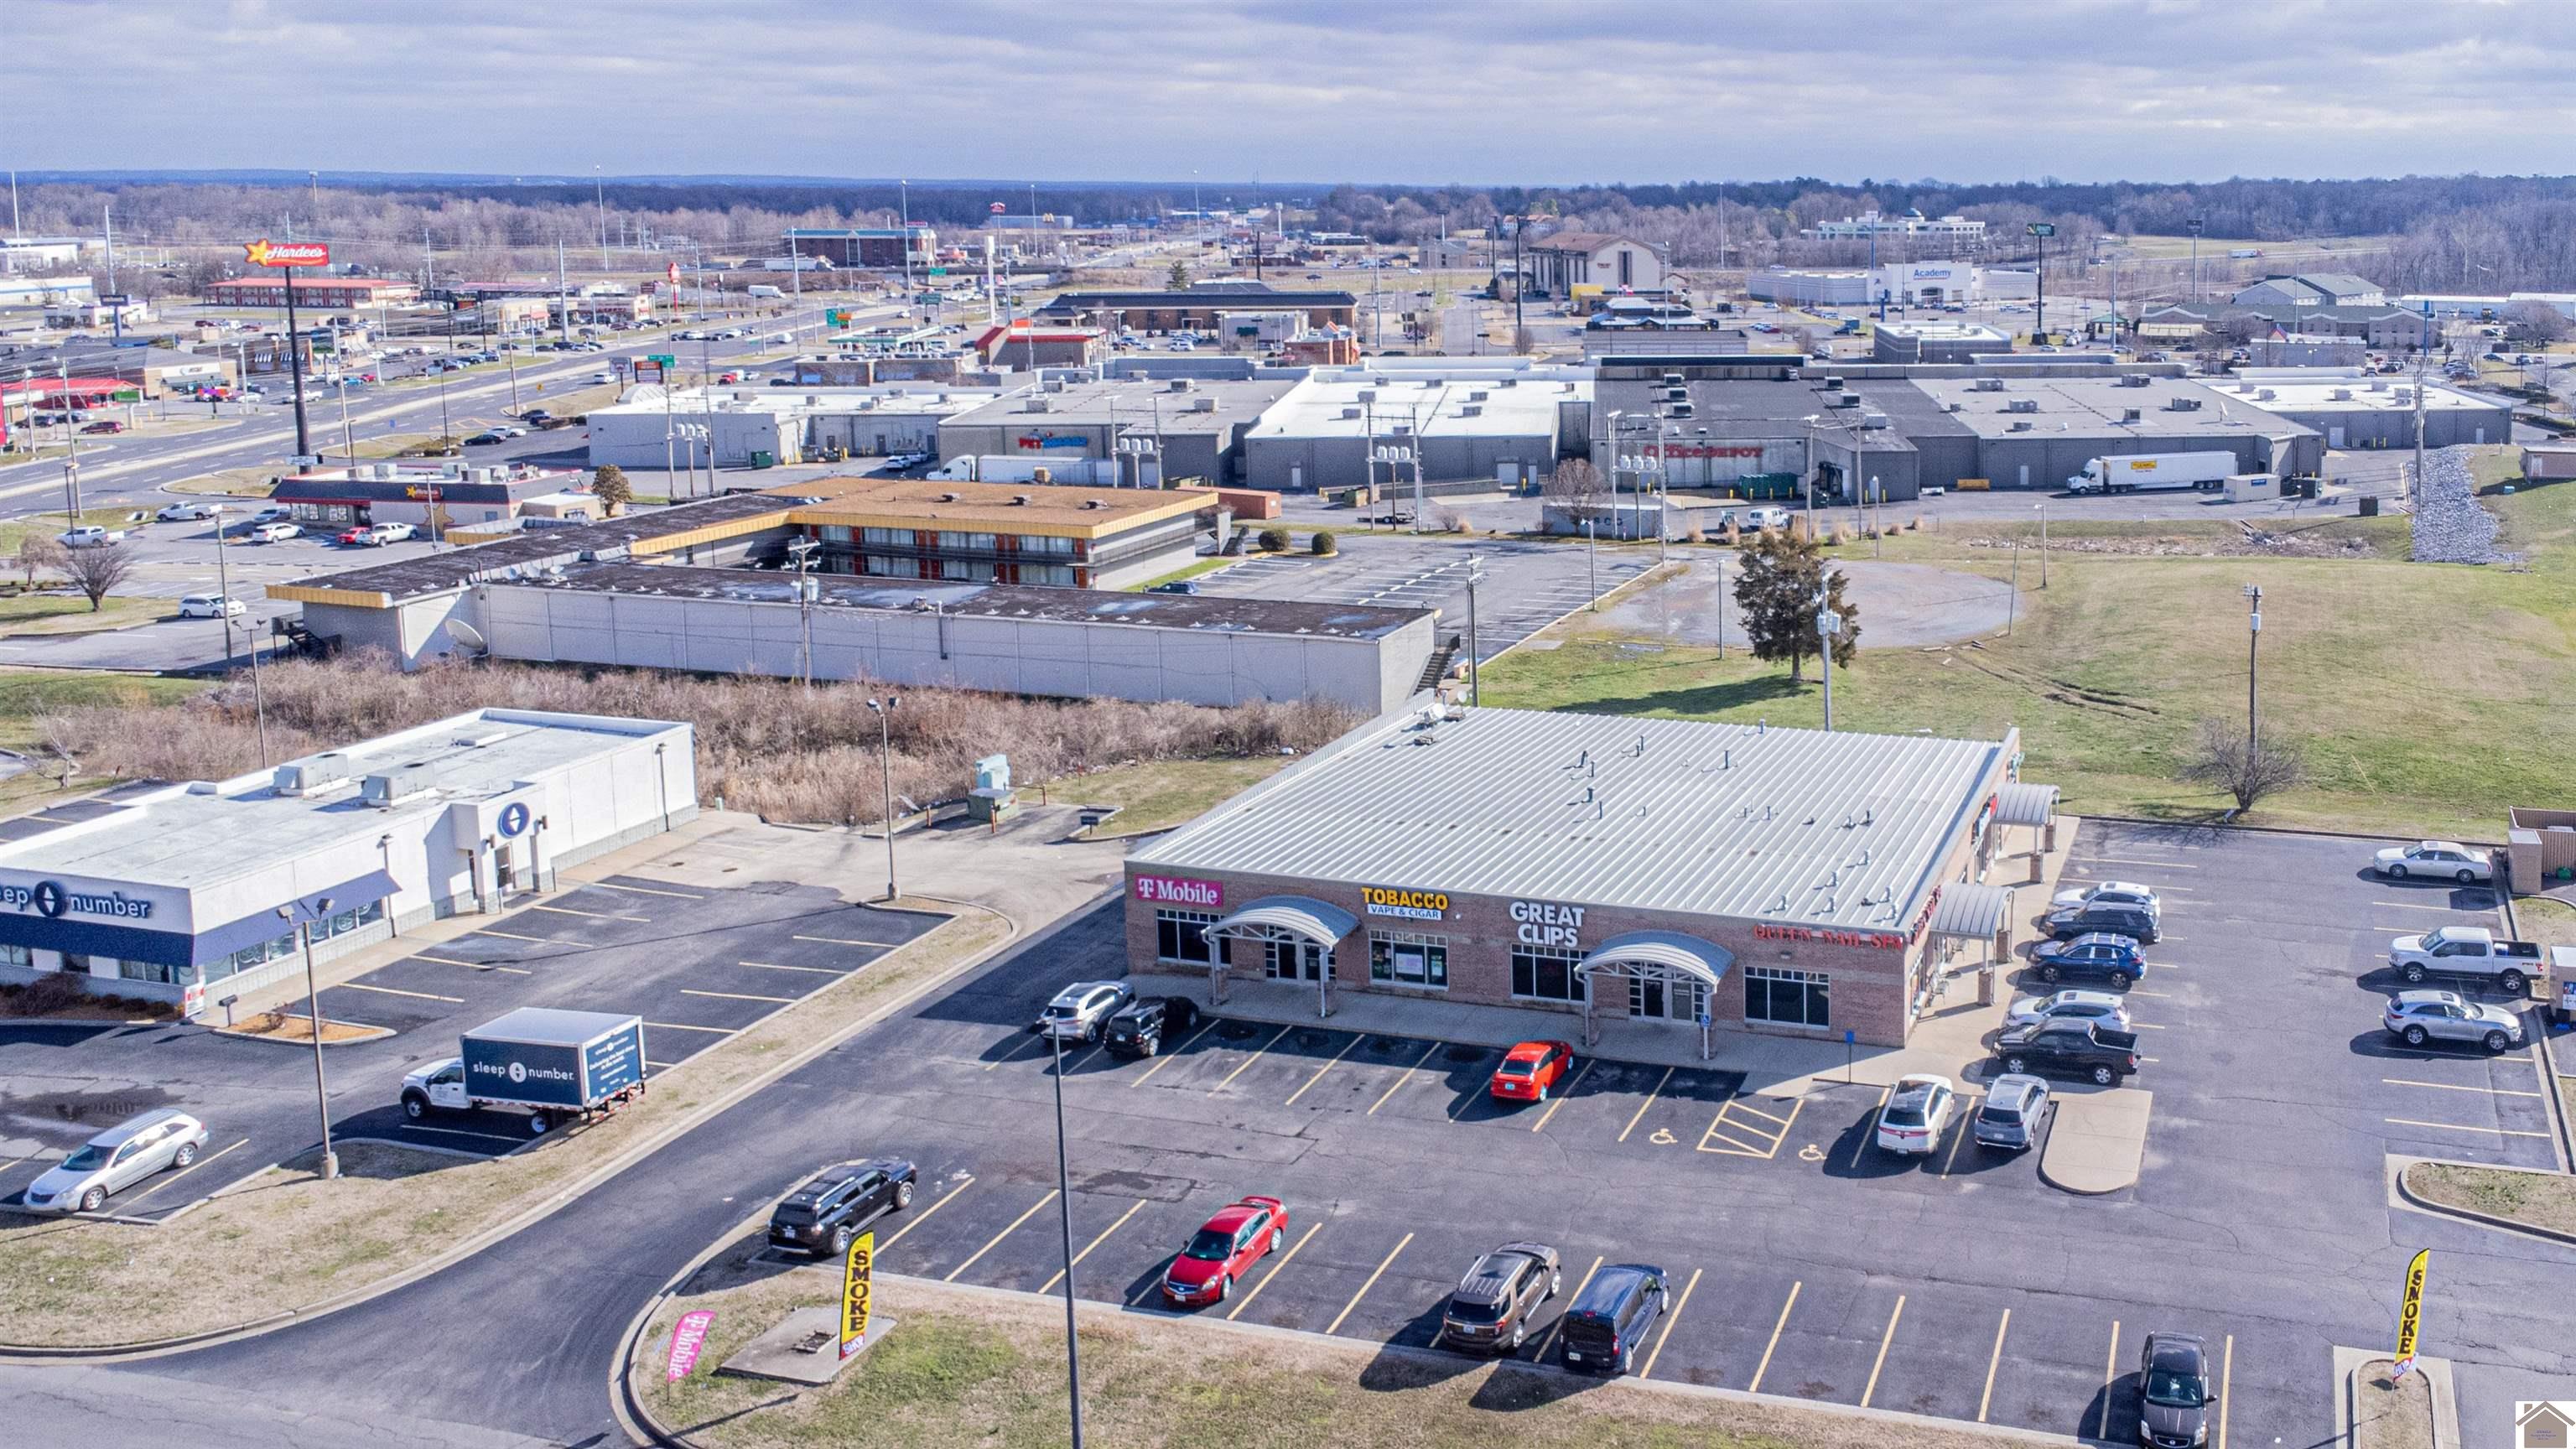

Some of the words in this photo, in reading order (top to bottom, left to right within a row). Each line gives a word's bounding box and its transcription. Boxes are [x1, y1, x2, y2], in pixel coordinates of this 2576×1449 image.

[265, 246, 326, 259] Hardee's
[1914, 268, 1951, 278] Academy
[0, 886, 29, 911] ep
[70, 891, 149, 918] number
[1361, 886, 1448, 911] TOBACCO
[1371, 905, 1397, 915] VAPE
[1399, 907, 1406, 916] &
[1409, 908, 1439, 919] CIGAR
[1509, 901, 1585, 927] GREAT
[1518, 923, 1578, 948] CLIPS
[1753, 924, 1812, 941] QUEEN
[1821, 929, 1861, 948] NAIL
[472, 1061, 506, 1078] sleep
[849, 1250, 870, 1332] SMOKE
[2399, 1269, 2423, 1354] SMOKE
